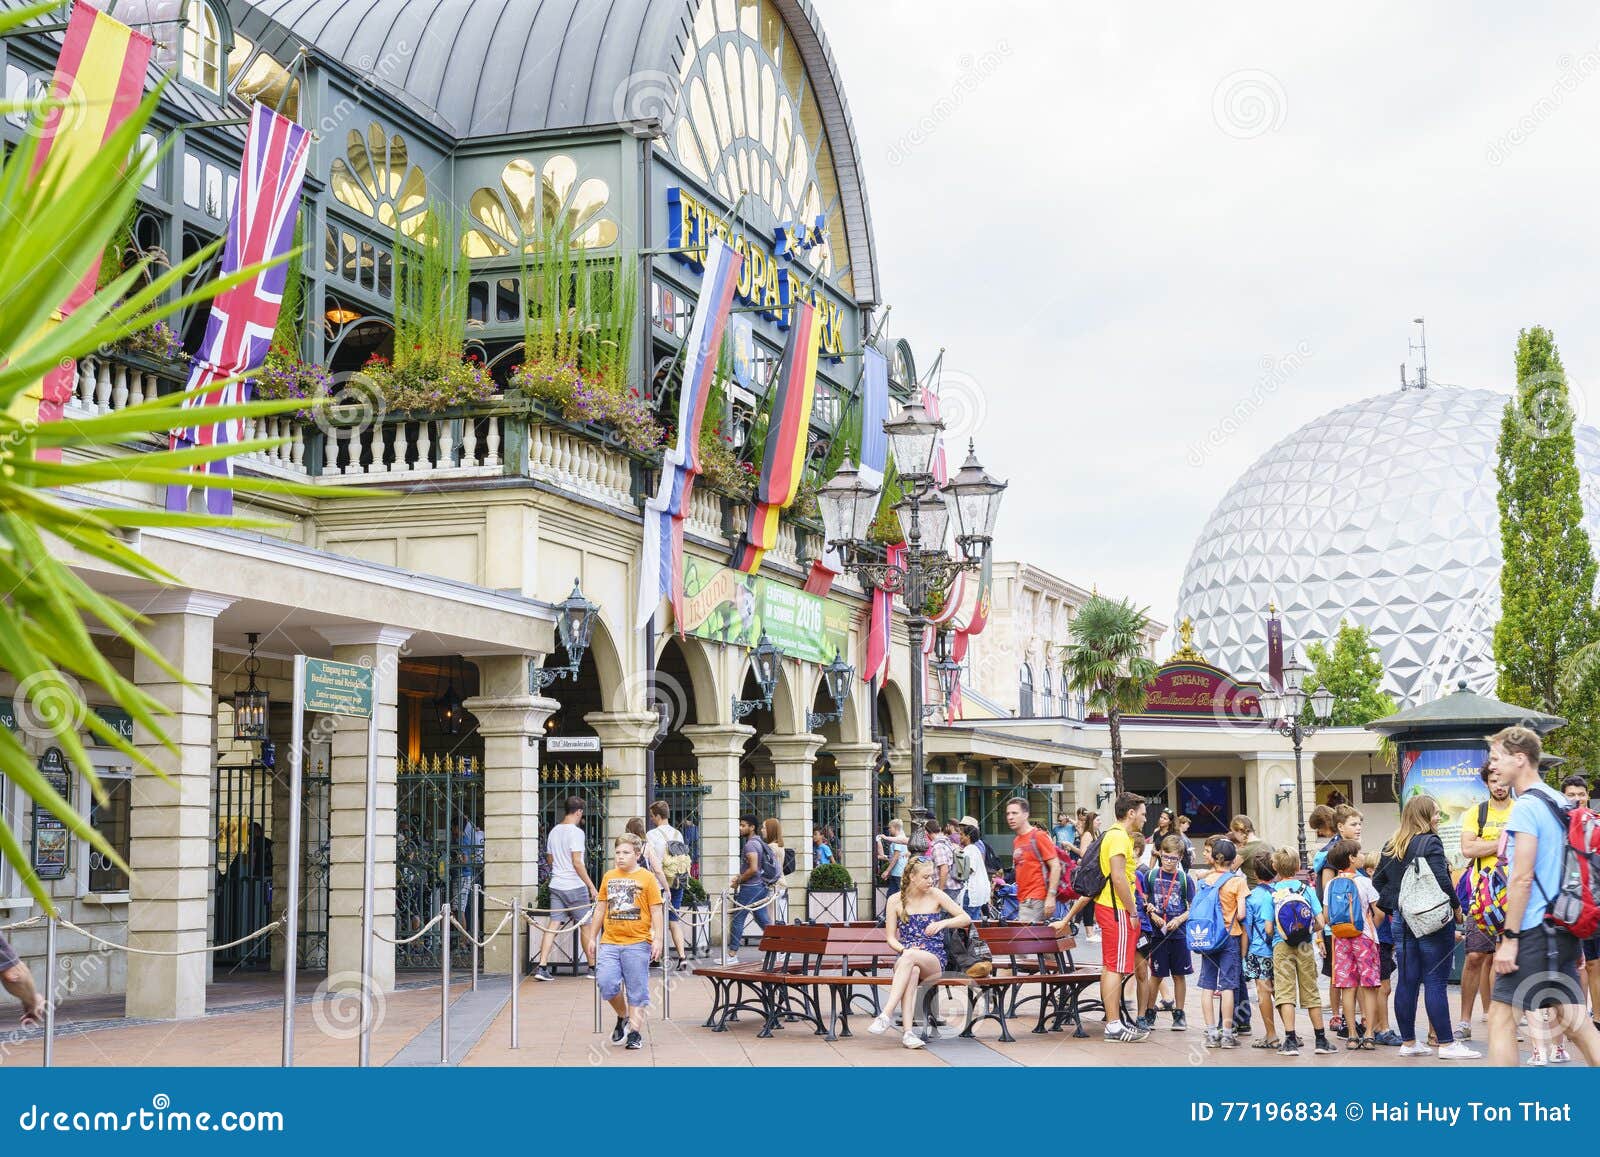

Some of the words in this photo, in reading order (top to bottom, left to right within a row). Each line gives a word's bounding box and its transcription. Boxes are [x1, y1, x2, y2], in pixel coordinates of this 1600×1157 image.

[796, 595, 822, 632] 2016
[322, 663, 341, 676] Eingang
[334, 677, 344, 685] und
[1171, 675, 1210, 688] EINGANG
[49, 753, 57, 762] 22
[1421, 767, 1452, 777] EUROPA
[1456, 767, 1480, 776] PARK
[1190, 940, 1211, 948] adidas
